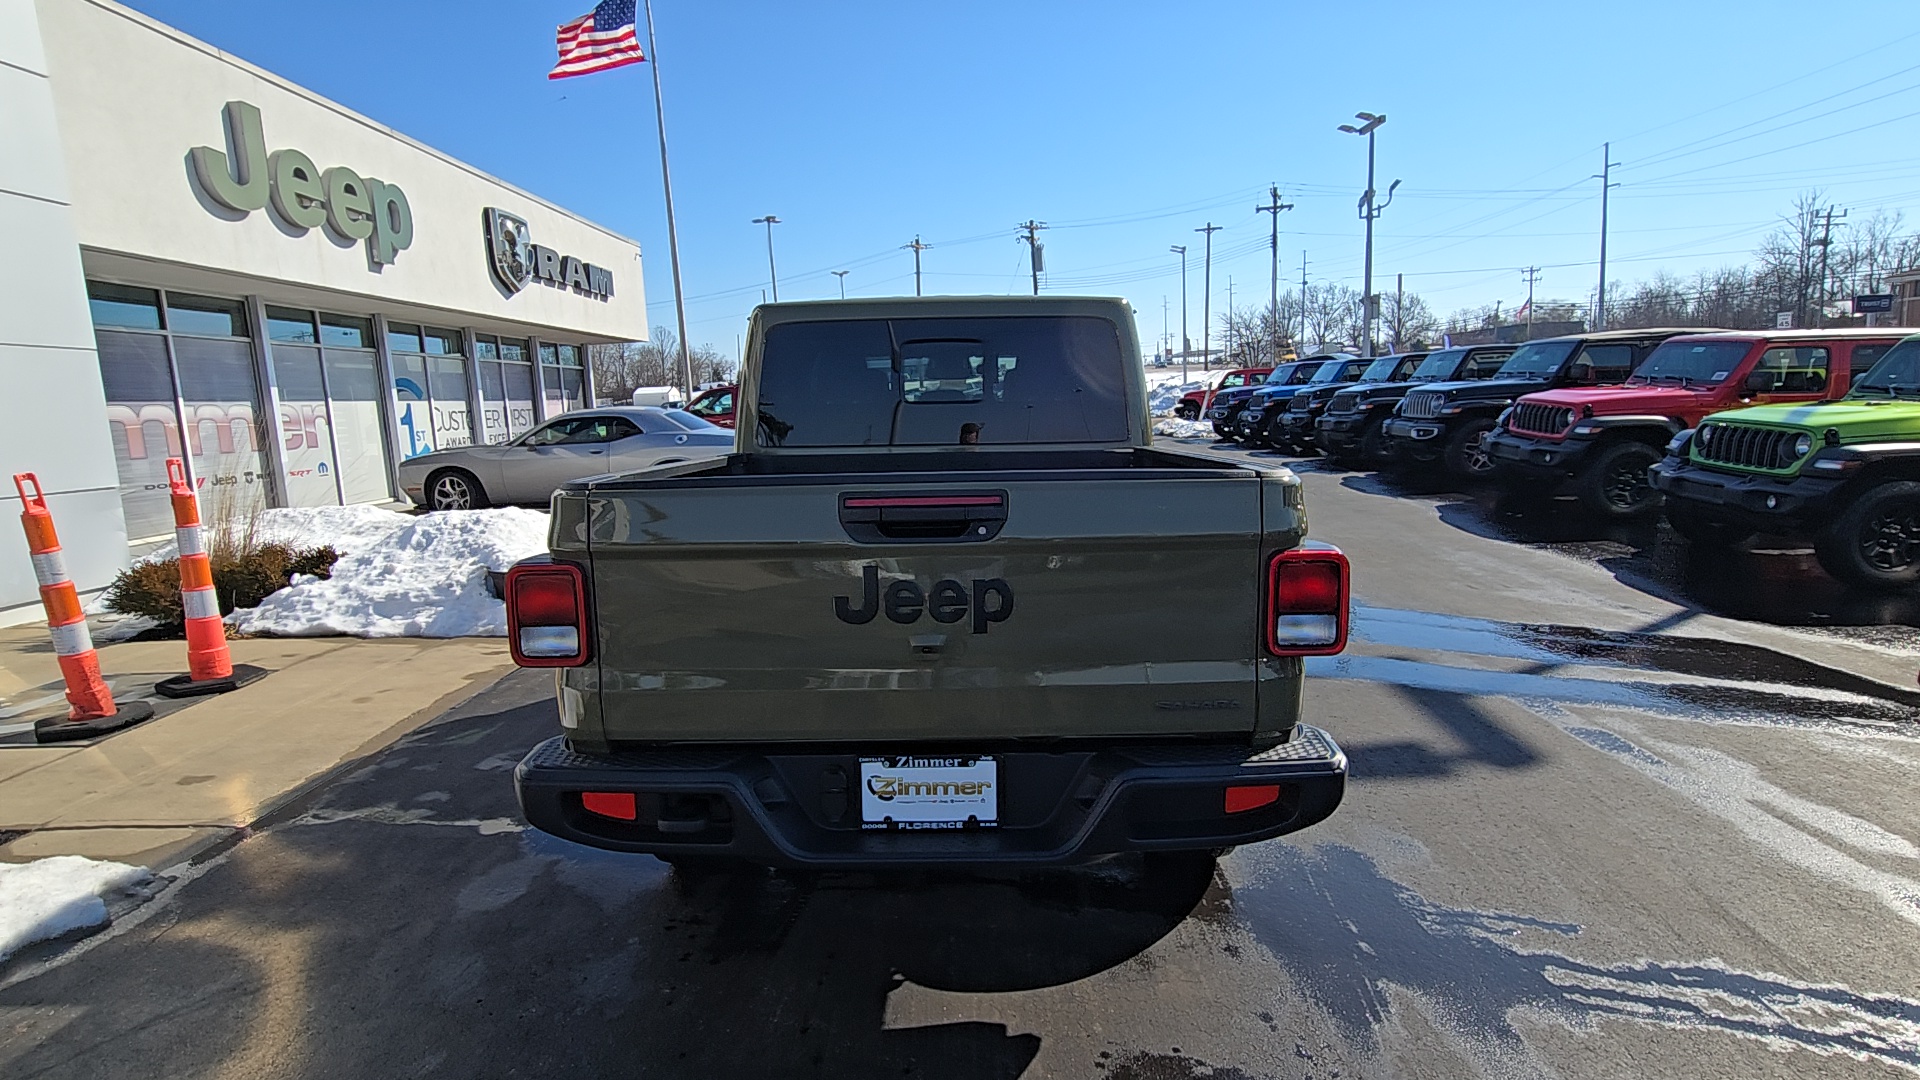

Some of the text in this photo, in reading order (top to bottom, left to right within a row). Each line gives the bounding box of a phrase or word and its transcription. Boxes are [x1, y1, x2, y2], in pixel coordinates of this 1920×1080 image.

[186, 101, 413, 265] Jeep
[532, 243, 615, 298] RAM
[211, 474, 238, 486] Jeep
[289, 469, 313, 477] SRT
[833, 565, 1014, 634] Jeep
[896, 756, 962, 768] Zimmer
[875, 776, 992, 796] Zimmer
